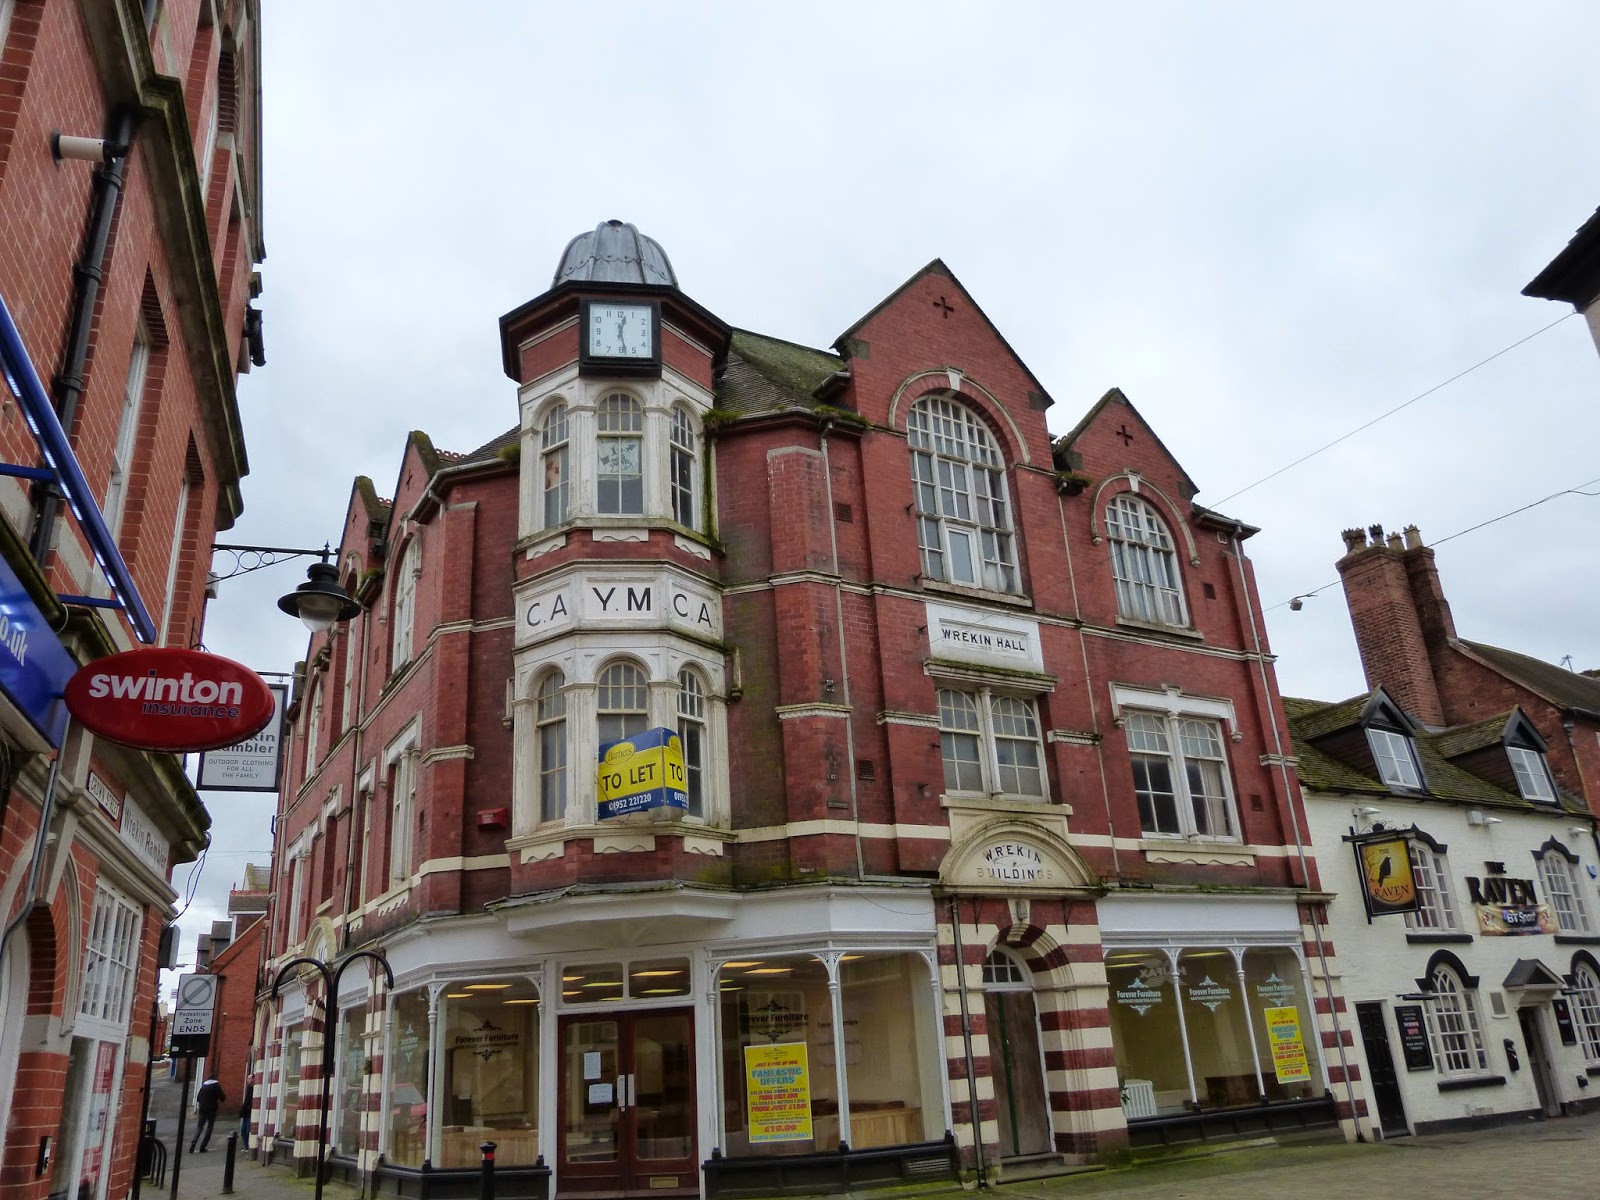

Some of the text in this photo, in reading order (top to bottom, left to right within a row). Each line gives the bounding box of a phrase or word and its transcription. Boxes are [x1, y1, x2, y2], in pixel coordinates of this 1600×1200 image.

[0, 614, 28, 667] o.uk
[942, 628, 1026, 651] WREKIN HALL
[88, 668, 243, 705] swinton
[142, 702, 240, 719] insurance
[219, 743, 274, 753] ambler
[603, 763, 656, 791] TO LET
[669, 763, 683, 781] TO
[608, 793, 652, 811] 01952 221220
[124, 806, 144, 846] Wrekin
[983, 844, 1041, 864] WREKIN
[977, 867, 1053, 880] BUILDINGS
[1374, 885, 1410, 898] RAVEN
[1465, 876, 1538, 906] RAVEN
[1506, 911, 1536, 924] BT Sport
[770, 1012, 809, 1022] Furniture
[179, 1025, 205, 1033] ENDS
[455, 1032, 519, 1044] Forever Furniture
[752, 1067, 802, 1078] FANTASTIC
[760, 1076, 796, 1086] OFFERS
